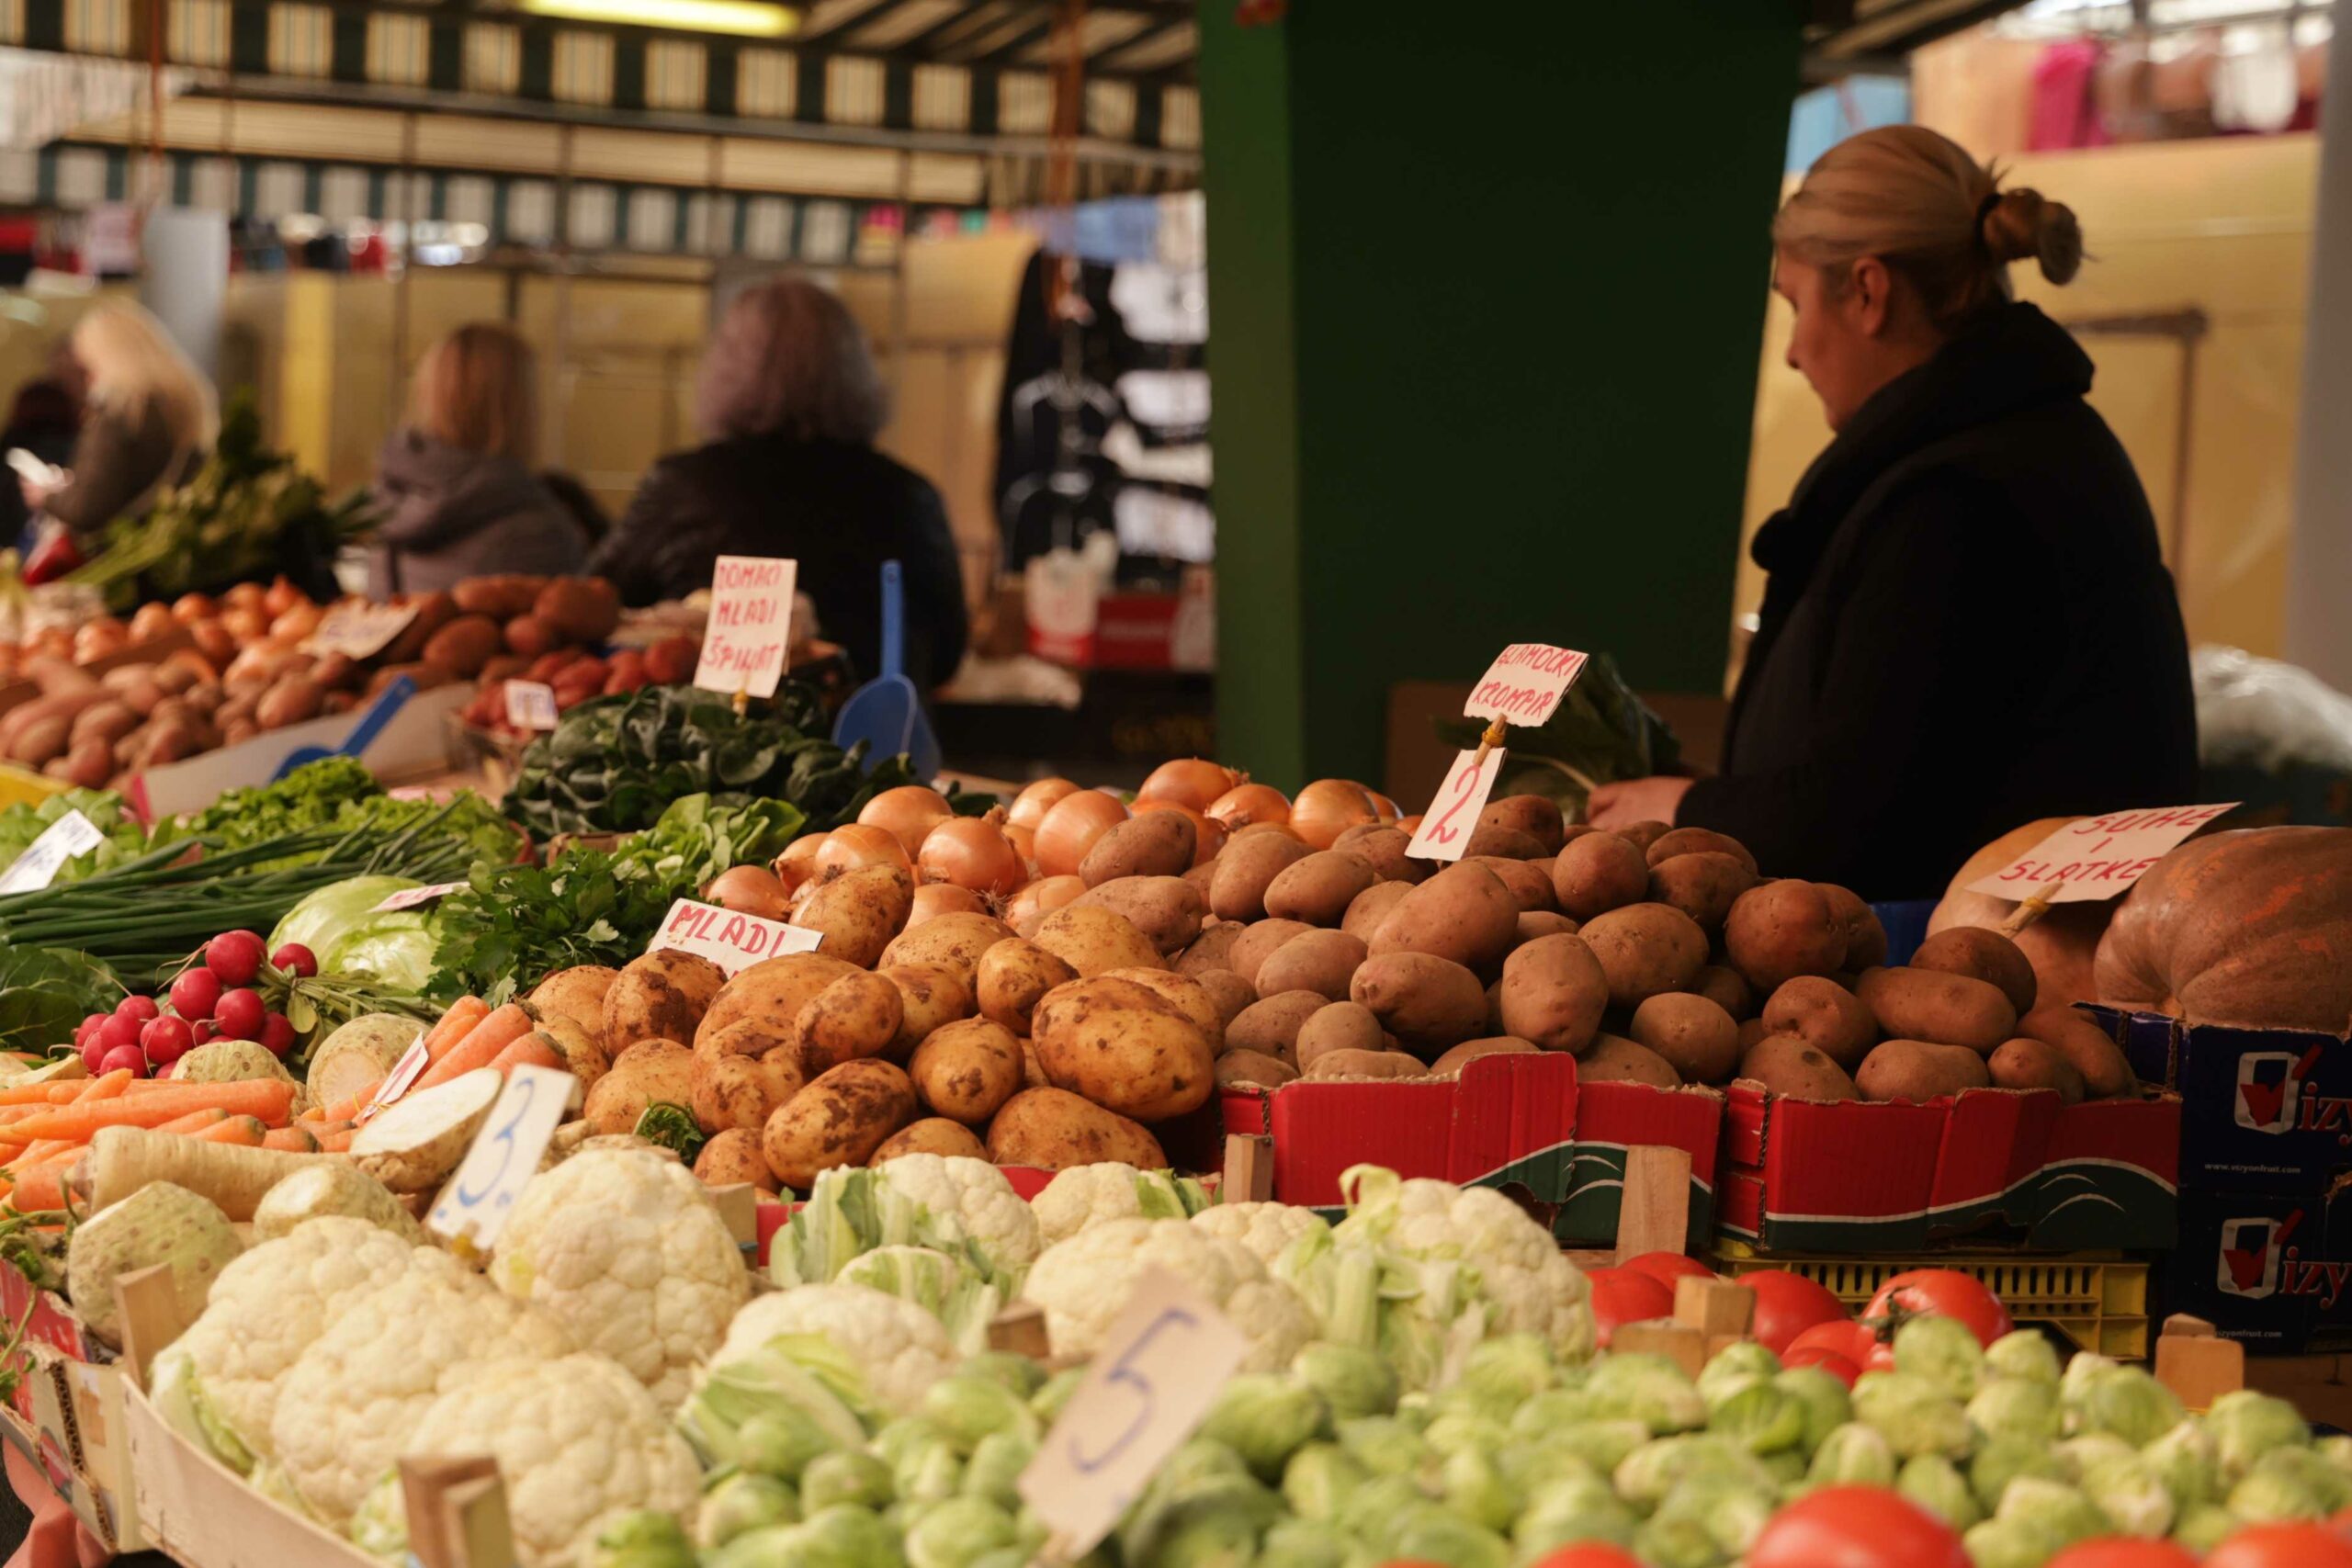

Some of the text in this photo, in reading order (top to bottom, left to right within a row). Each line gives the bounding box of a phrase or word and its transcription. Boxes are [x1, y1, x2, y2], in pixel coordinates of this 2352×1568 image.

[1472, 682, 1555, 717] KROMPIR
[1425, 764, 1481, 844] 2
[2073, 806, 2233, 834] SUHE
[1999, 856, 2163, 882] SLATKE
[667, 904, 786, 959] MLADI
[2215, 1329, 2284, 1338] izyonfruit.com
[1068, 1306, 1200, 1474] 5
